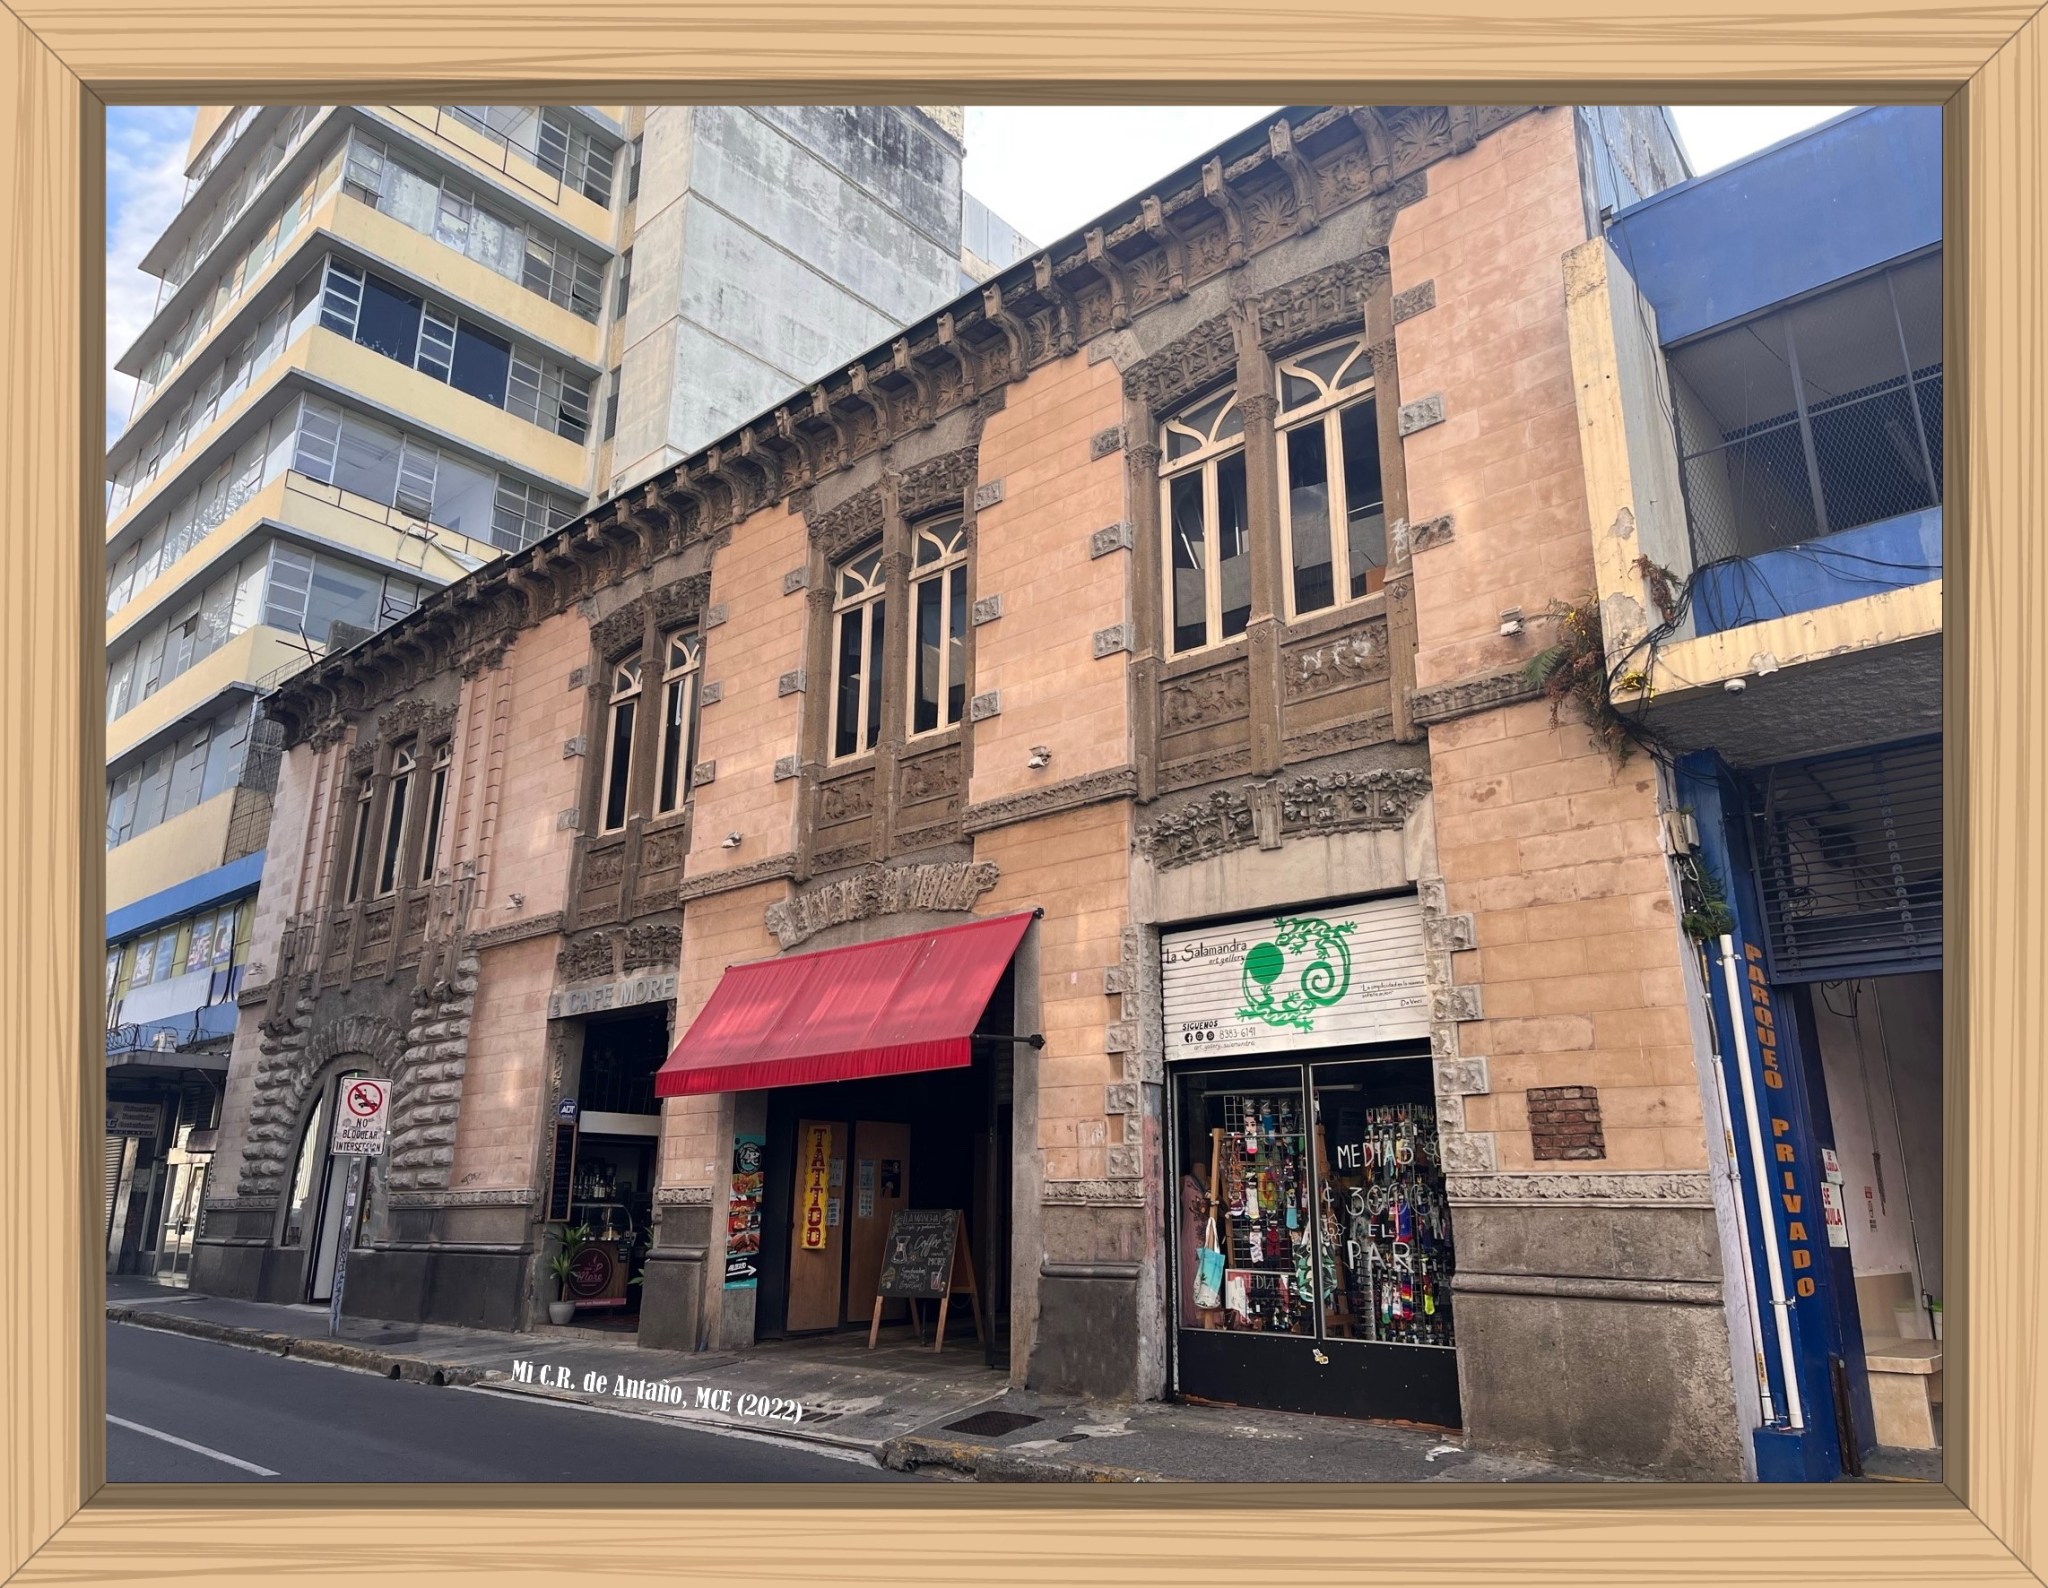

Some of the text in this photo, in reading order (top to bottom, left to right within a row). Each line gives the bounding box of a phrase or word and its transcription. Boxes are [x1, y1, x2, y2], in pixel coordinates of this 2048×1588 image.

[1166, 938, 1247, 964] La Salamandra
[620, 974, 675, 1006] MORE
[1182, 1020, 1218, 1032] SIGUENOS
[1744, 942, 1783, 1090] PARQUEO
[356, 1118, 368, 1128] NO
[560, 1105, 576, 1114] ADT
[342, 1129, 379, 1140] BLOQUEAR
[1337, 1140, 1414, 1170] MEDIAS
[806, 1128, 827, 1247] TATTOO
[1345, 1182, 1433, 1217] 3000
[1771, 1117, 1816, 1298] PRIVADO
[1368, 1223, 1395, 1238] EL
[914, 1233, 942, 1257] Coffee
[1346, 1239, 1415, 1274] PAR
